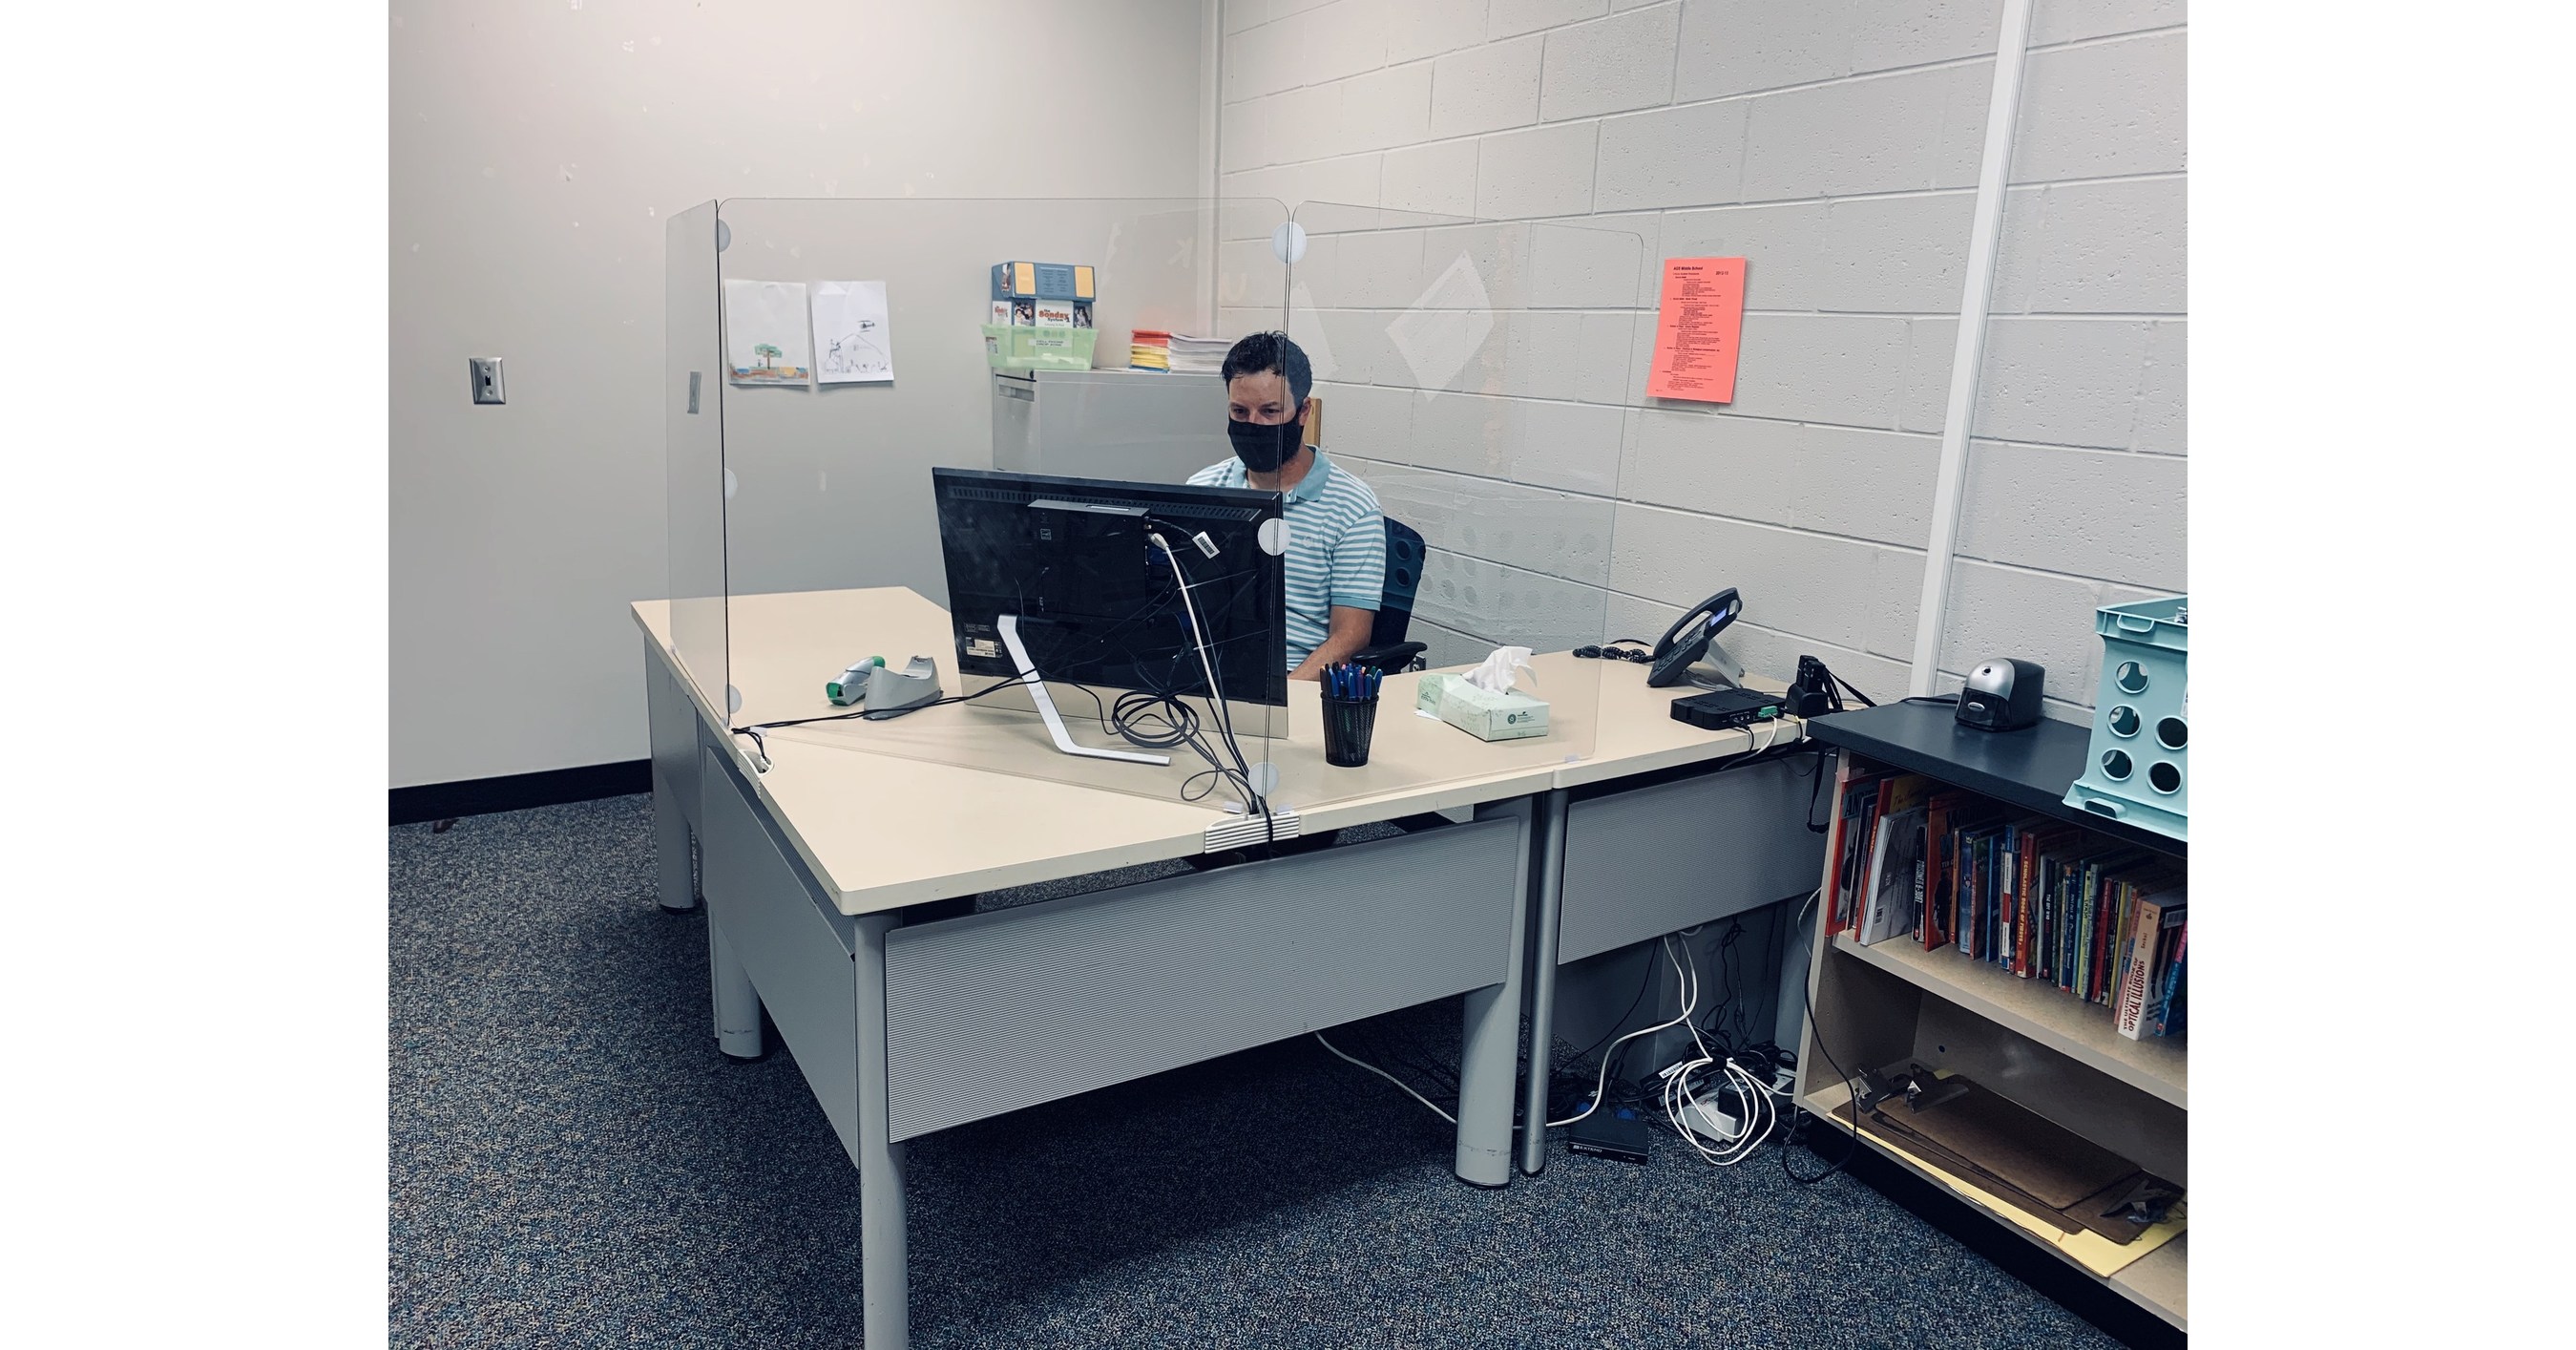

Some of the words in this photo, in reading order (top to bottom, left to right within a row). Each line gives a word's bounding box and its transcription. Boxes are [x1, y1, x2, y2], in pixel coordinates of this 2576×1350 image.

[2021, 860, 2029, 896] SCHOLASTIC
[2132, 958, 2139, 966] OF
[2130, 960, 2146, 1001] ILLUSIONS
[2127, 1002, 2142, 1031] OPTICAL
